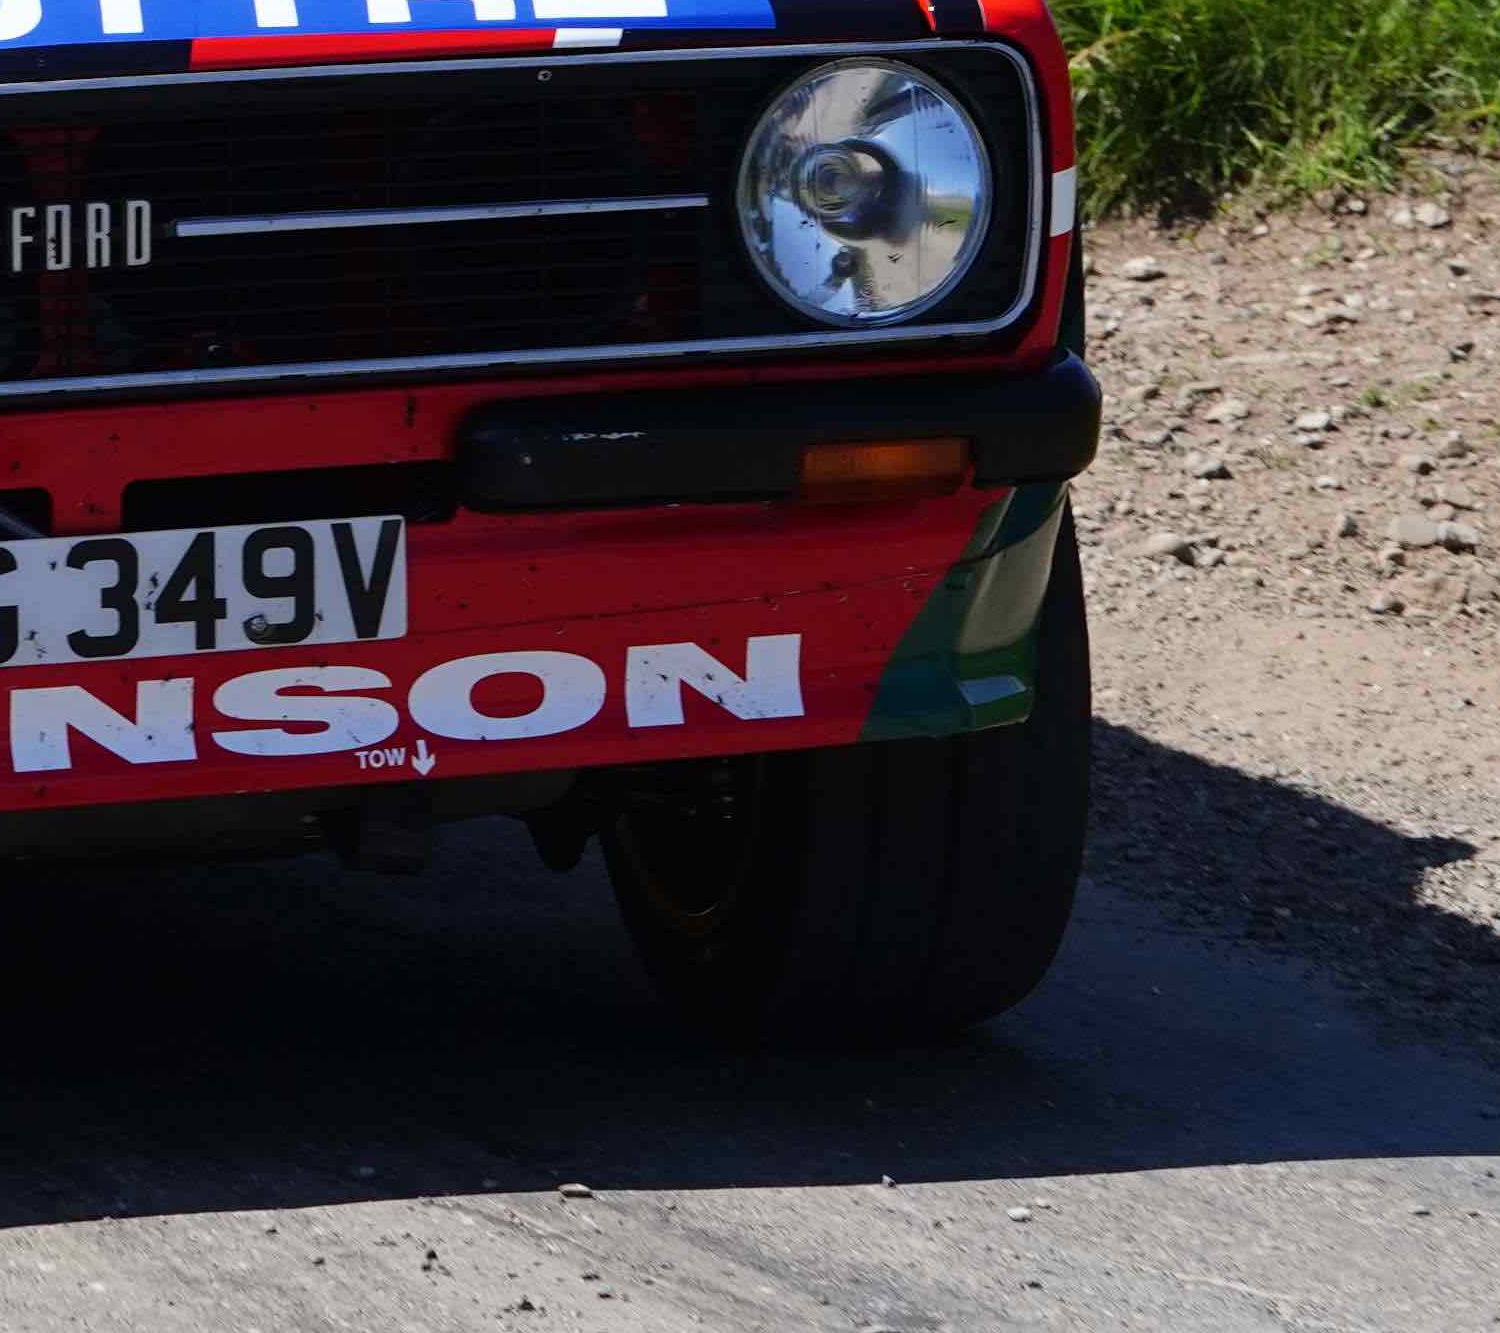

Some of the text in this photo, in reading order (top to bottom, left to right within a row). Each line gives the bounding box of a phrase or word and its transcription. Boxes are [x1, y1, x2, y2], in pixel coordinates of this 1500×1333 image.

[11, 199, 152, 272] FORD
[64, 518, 403, 659] 349V
[354, 746, 406, 769] TOW
